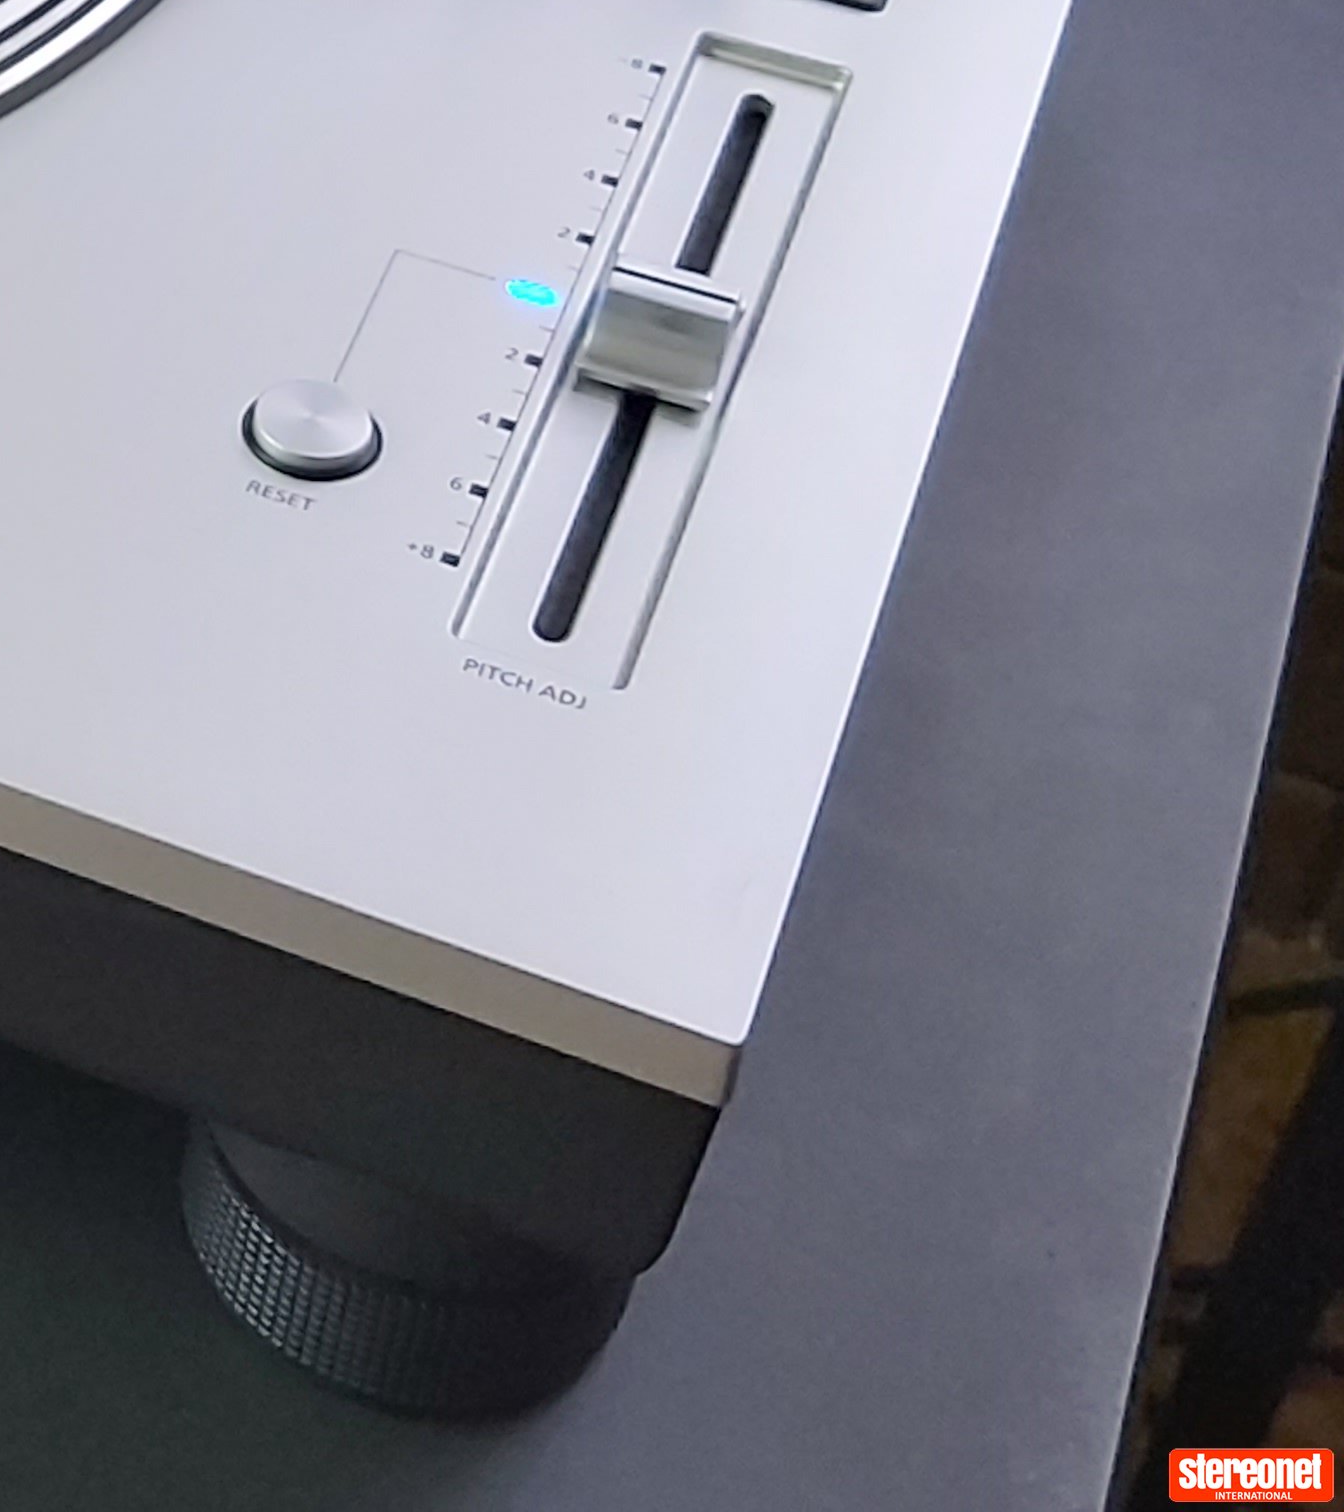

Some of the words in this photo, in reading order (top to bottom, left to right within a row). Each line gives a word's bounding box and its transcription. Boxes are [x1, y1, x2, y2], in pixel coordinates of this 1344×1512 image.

[245, 479, 318, 511] RESET
[462, 657, 534, 693] PITCH
[538, 684, 588, 710] ADJ
